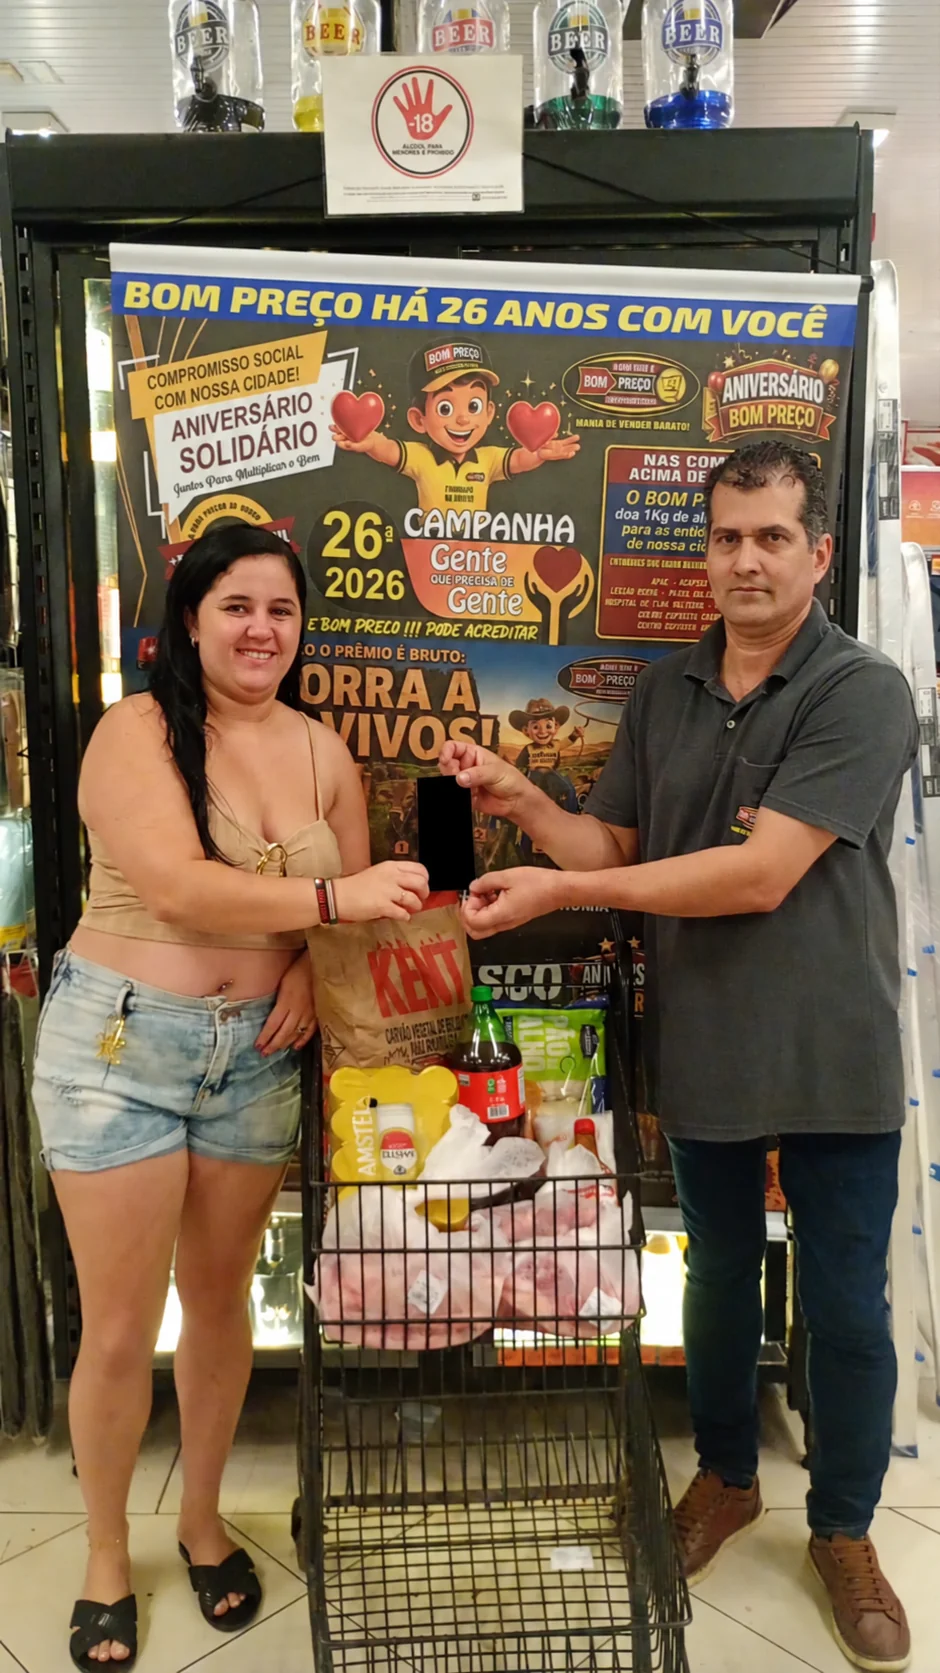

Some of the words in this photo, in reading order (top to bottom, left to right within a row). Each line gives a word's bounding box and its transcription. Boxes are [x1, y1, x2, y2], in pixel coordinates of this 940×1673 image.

[177, 26, 229, 54] BEER
[305, 23, 361, 45] BEER
[435, 20, 490, 47] BEER
[551, 30, 606, 51] BEER
[665, 22, 720, 46] BEER
[408, 113, 434, 133] -18
[124, 280, 221, 312] BOM
[230, 286, 362, 327] PREÇO
[371, 287, 429, 323] HÁ
[437, 297, 489, 325] 26
[494, 300, 609, 330] ANOS
[618, 305, 712, 335] COM
[721, 304, 828, 339] VOCÊ
[147, 355, 250, 390] COMPROMISSO
[254, 345, 304, 368] SOCIAL
[429, 347, 451, 365] BOM
[453, 346, 480, 360] PREÇO
[155, 388, 187, 410] COM
[190, 379, 240, 402] NOSSA
[243, 366, 300, 391] CIDADE!
[584, 375, 608, 389] BOM
[618, 376, 651, 392] PREÇO
[722, 369, 824, 404] ANIVERSÁRIO
[171, 391, 313, 442] ANIVERSÁRIO
[576, 418, 604, 428] MANIA
[606, 419, 617, 428] DE
[619, 419, 652, 430] VENDER
[653, 421, 690, 431] BARATO!
[729, 404, 763, 428] BOM
[768, 404, 815, 430] PREÇO
[180, 420, 318, 474] SOLIDÁRIO
[643, 453, 680, 467] NAS
[173, 481, 204, 498] Juntos
[206, 474, 233, 488] Para
[235, 460, 288, 481] Multiplicar
[288, 460, 295, 468] o
[296, 452, 321, 468] Bem
[629, 468, 682, 482] ACIMA
[687, 470, 707, 483] DE
[626, 489, 640, 505] O
[645, 490, 688, 507] BOM
[404, 507, 576, 544] CAMPANHA
[615, 508, 639, 520] doa
[644, 508, 669, 525] 1Kg
[673, 510, 689, 522] de
[621, 524, 651, 537] para
[655, 527, 670, 536] as
[627, 537, 643, 549] de
[647, 541, 686, 551] nossa
[430, 543, 507, 573] Gente
[325, 567, 405, 601] 2026
[431, 574, 452, 585] QUE
[455, 574, 498, 587] PRECISA
[501, 576, 514, 587] DE
[448, 586, 523, 616] Gente
[320, 617, 351, 634] BOM
[354, 618, 401, 635] PRECO
[403, 621, 422, 638] !!!
[425, 621, 463, 638] PODE
[464, 623, 539, 640] ACREDITAR
[320, 644, 331, 657] O
[335, 642, 393, 660] PRÊMIO
[396, 644, 406, 660] É
[409, 648, 465, 663] BRUTO:
[300, 662, 432, 711] ORRA
[442, 670, 477, 712] A
[575, 673, 596, 685] BOM
[606, 675, 635, 687] PREÇO
[320, 711, 494, 761] VIVOS!
[367, 938, 466, 1019] KENT
[518, 1016, 546, 1071] ALHO
[352, 1101, 376, 1176] AMSTEL
